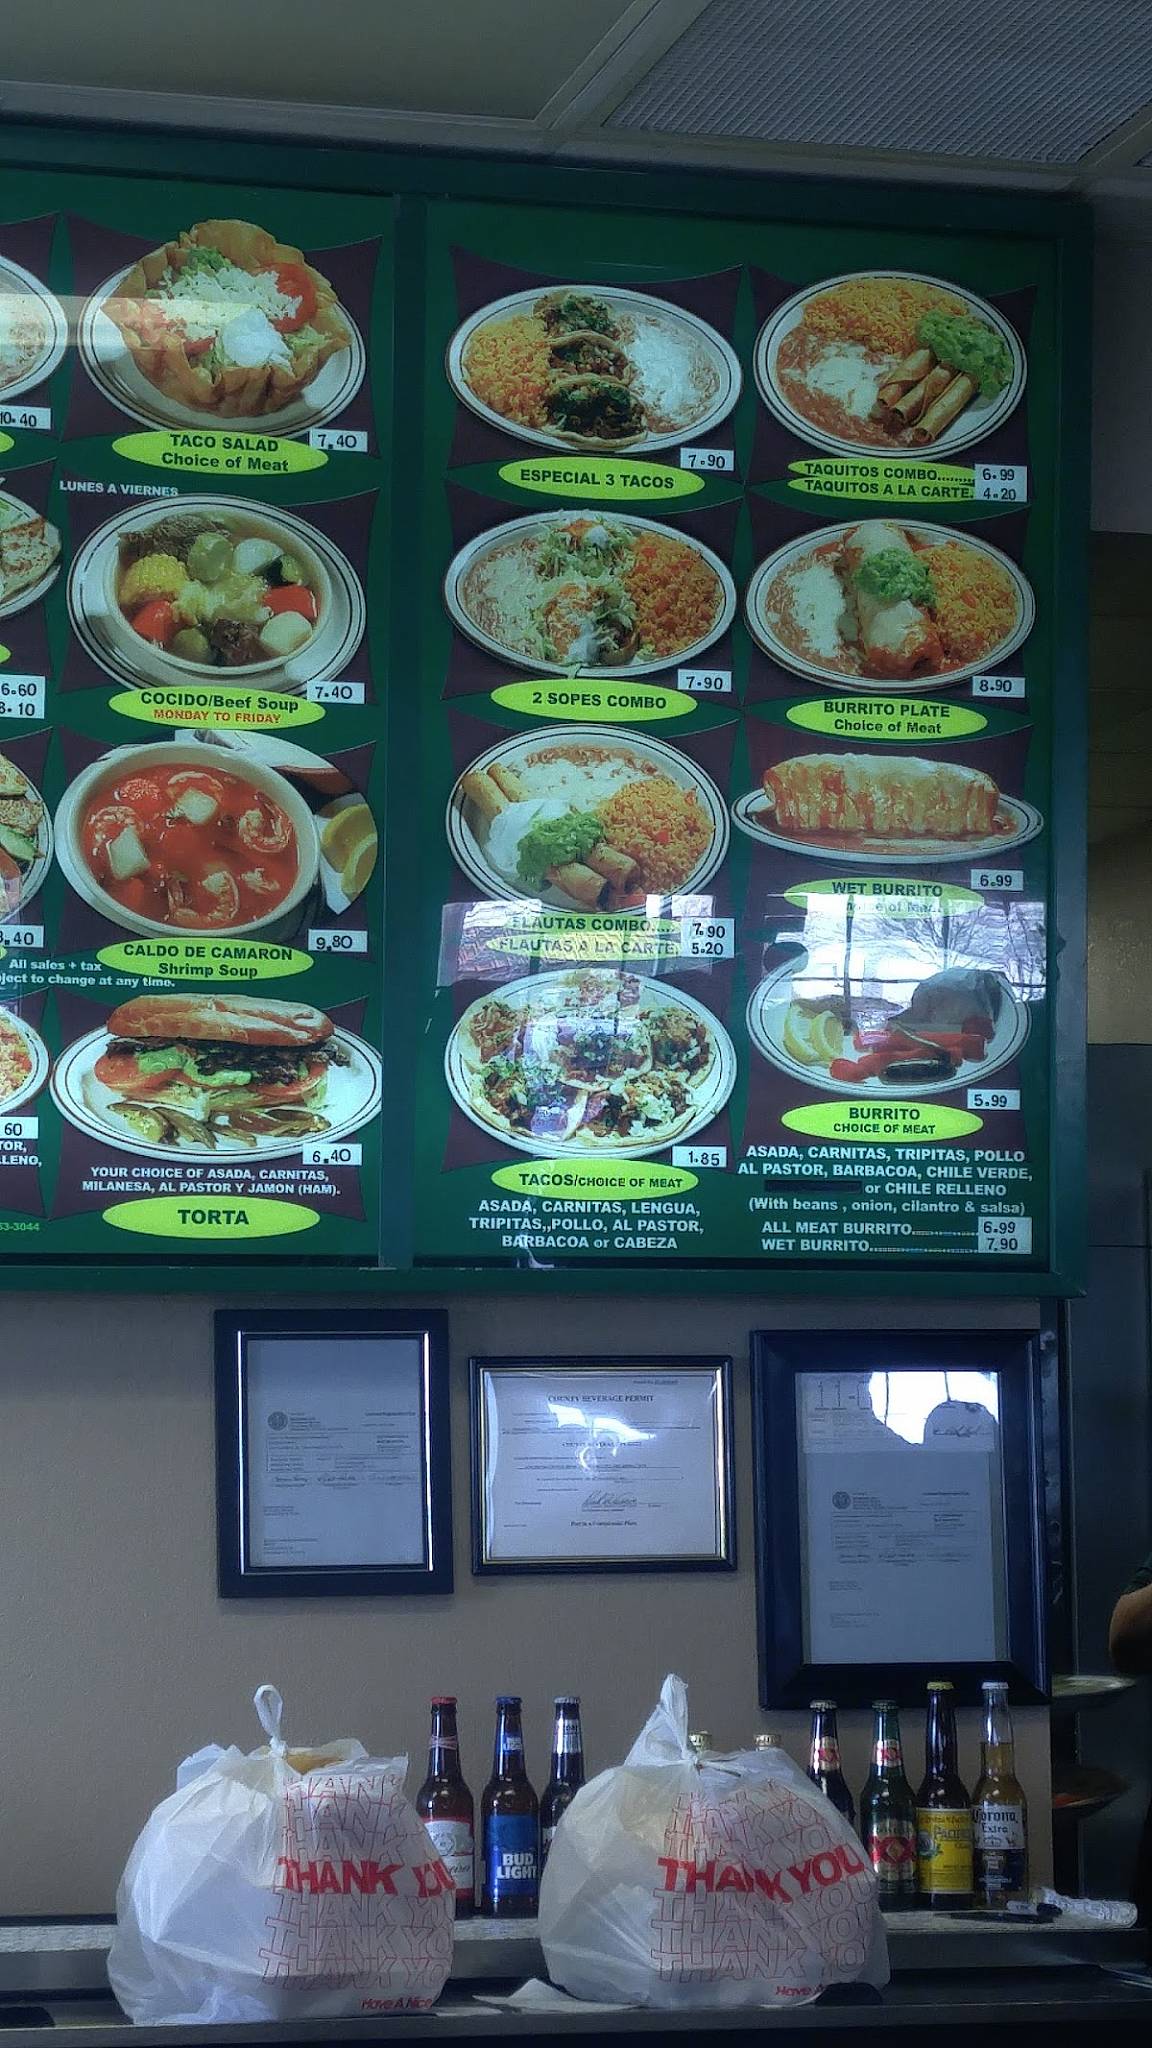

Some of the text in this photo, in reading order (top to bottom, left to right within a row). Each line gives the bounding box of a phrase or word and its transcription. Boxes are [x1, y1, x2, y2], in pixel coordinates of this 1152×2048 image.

[170, 434, 278, 451] TACO SALAD
[318, 434, 356, 449] 7.40
[162, 452, 289, 472] Choice of Meat
[688, 455, 725, 469] 7.90
[805, 463, 879, 478] TAQUITOS
[983, 468, 1015, 481] 6.99
[520, 469, 675, 489] ESPECIAL 3 TACOS
[60, 480, 179, 497] LUNES A VIERNES
[804, 480, 879, 494] TAQUITOS
[883, 484, 893, 495] A
[898, 485, 916, 496] LA
[983, 488, 1017, 501] 4.20
[1, 683, 37, 697] 6.60
[686, 676, 723, 690] 7.90
[979, 679, 1012, 693] 8.90
[315, 685, 353, 700] 7.40
[141, 691, 299, 714] COCIDO/Beef Soup
[532, 692, 667, 709] 2 SOPES COMBO
[154, 709, 282, 725] MONDAY TO FRIDAY
[824, 701, 950, 718] BURRITO PLATE
[834, 718, 942, 735] Choice of Meat
[980, 874, 1012, 887] 6.99
[832, 881, 943, 897] WET BURRITO
[512, 916, 586, 930] FLAUTAS
[693, 922, 726, 938] 7.90
[316, 935, 353, 951] 9.80
[500, 939, 573, 953] FLAUTAS
[595, 941, 614, 953] LA
[692, 942, 724, 956] 5.20
[124, 944, 293, 961] CALDO DE CAMARON
[9, 959, 27, 970] All
[30, 960, 66, 971] sales
[81, 961, 102, 972] tax
[158, 961, 258, 979] Shrimp Soup
[31, 973, 45, 984] to
[48, 973, 95, 988] change
[99, 976, 112, 986] at
[116, 978, 139, 990] any
[143, 976, 176, 988] time.
[973, 1093, 1008, 1107] 5.99
[849, 1107, 920, 1120] BURRITO
[833, 1123, 936, 1135] CHOICE OF MEAT
[312, 1148, 351, 1164] 6.40
[688, 1151, 720, 1166] 1.85
[746, 1145, 1025, 1164] ASADA, CARNITAS, TRIPITAS, POLLO
[91, 1167, 329, 1182] YOUR CHOICE OF ASADA, CARNITAS,
[737, 1163, 1033, 1181] AL PASTOR, BARBACOA, CHILE VERDE,
[82, 1180, 341, 1197] MILANESA, AL PASTOR Y JAMON (HAM).
[519, 1173, 683, 1189] TACOS/CHOICE OF MEAT
[865, 1182, 1007, 1197] or CHILE RELLENO
[478, 1200, 701, 1217] ASADA, CARNITAS, LENGUA,
[749, 1197, 1025, 1216] (With beans onion, cilantro & salsa)
[178, 1209, 250, 1225] TORTA
[612, 1220, 632, 1231] AL
[637, 1221, 704, 1234] PASTOR,
[762, 1222, 791, 1234] ALL
[795, 1222, 838, 1234] MEAT
[983, 1221, 1016, 1235] 6.99
[501, 1235, 678, 1249] BARBACOA or CABEZA
[762, 1239, 795, 1251] WET
[987, 1238, 1018, 1252] 7.90
[502, 1852, 534, 1866] BUD
[278, 1857, 404, 1896] THANK
[496, 1865, 537, 1880] LIGHT
[658, 1856, 793, 1904] THANK
[788, 1845, 865, 1894] YOU
